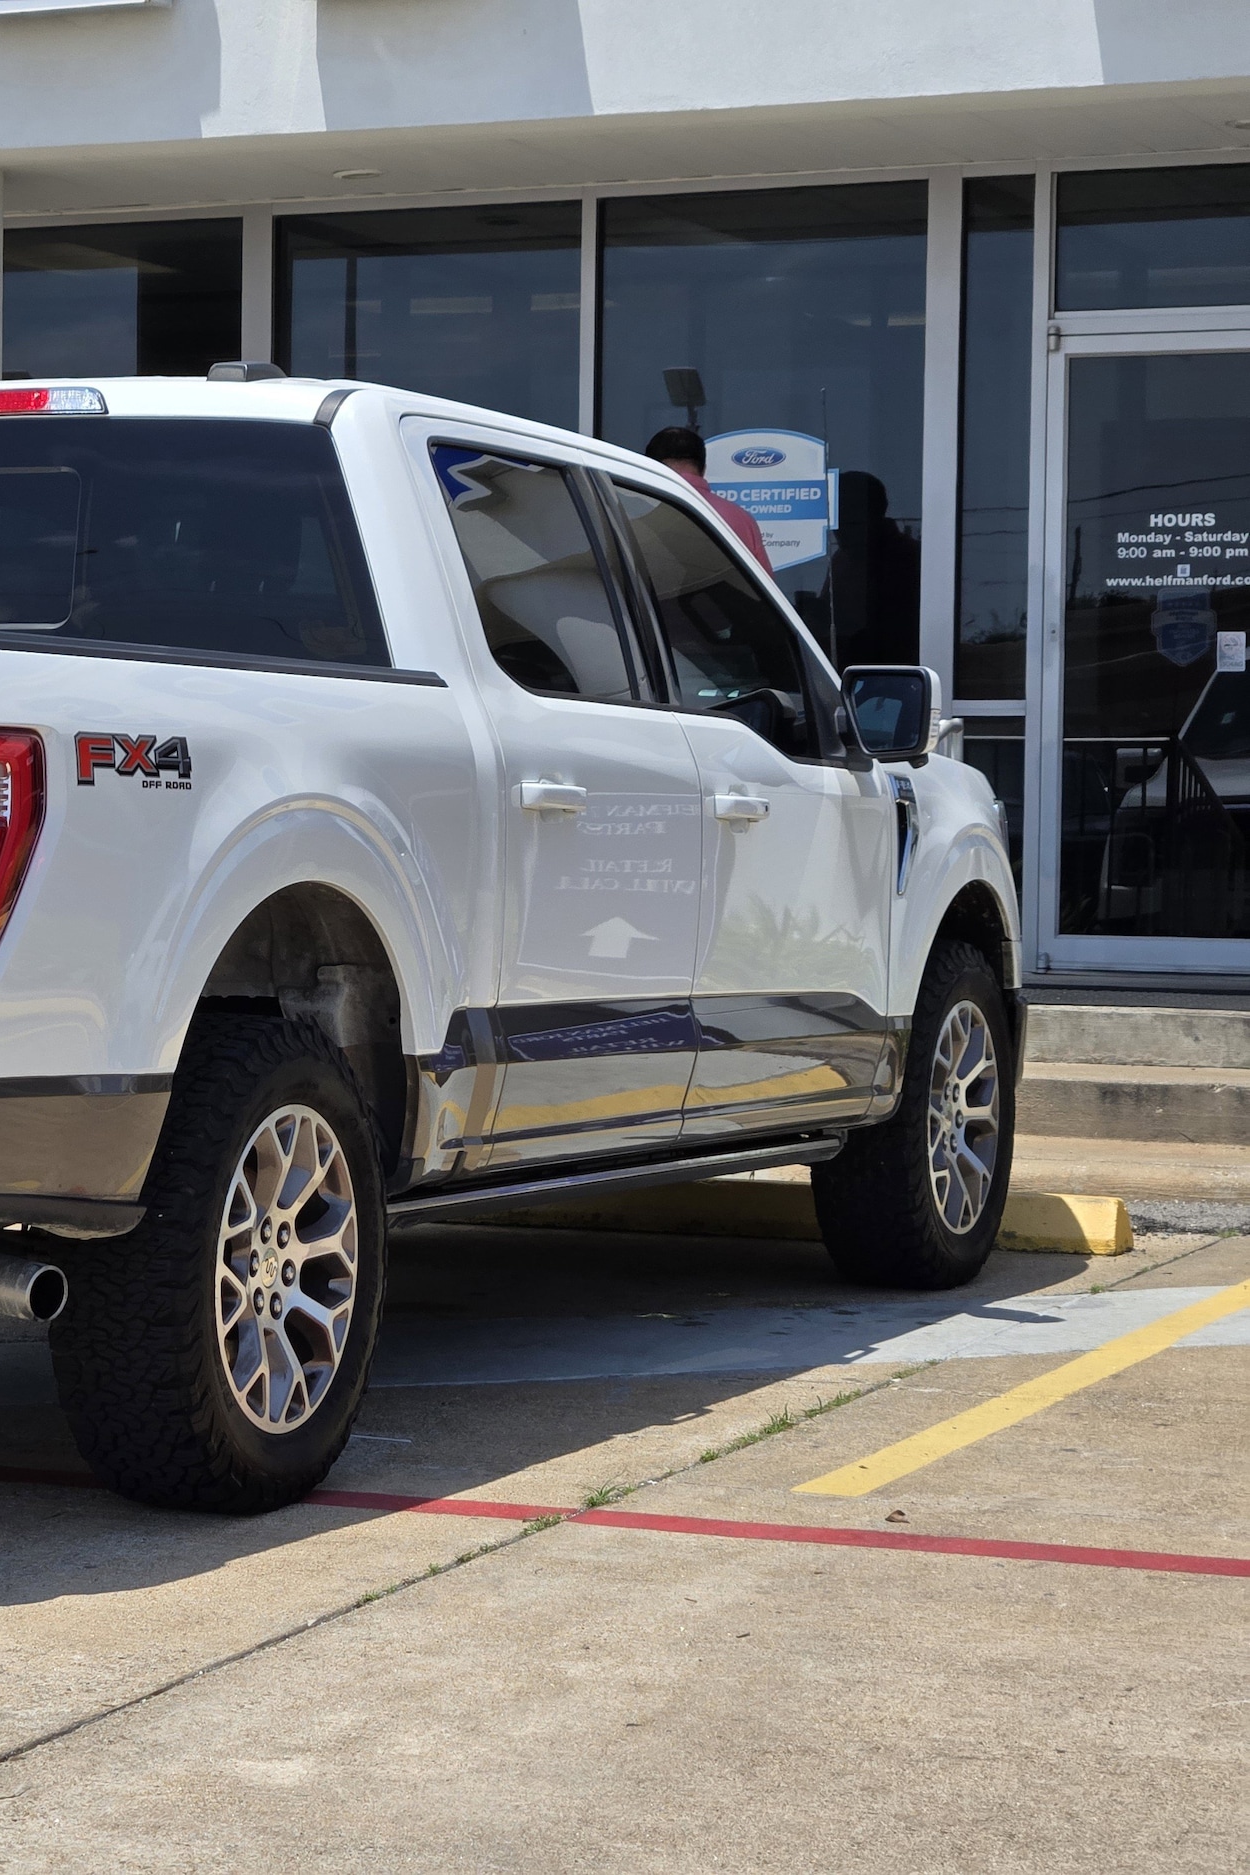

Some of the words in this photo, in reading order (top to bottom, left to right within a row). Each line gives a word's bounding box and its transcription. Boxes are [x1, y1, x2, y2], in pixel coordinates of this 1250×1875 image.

[742, 450, 775, 464] Ford
[710, 489, 738, 501] RD
[740, 488, 821, 501] CERTIFIED
[740, 504, 792, 514] -OWNED
[1149, 513, 1216, 527] HOURS
[1117, 532, 1172, 545] Monday
[1184, 530, 1249, 544] Saturday
[1117, 547, 1147, 558] 9:00
[1152, 548, 1176, 557] am
[1189, 546, 1221, 557] 9:00
[1225, 548, 1249, 559] pm
[1106, 574, 1250, 586] www.helfmanford.co
[74, 731, 192, 786] FX4
[142, 780, 162, 789] OFF
[165, 781, 192, 790] ROAD
